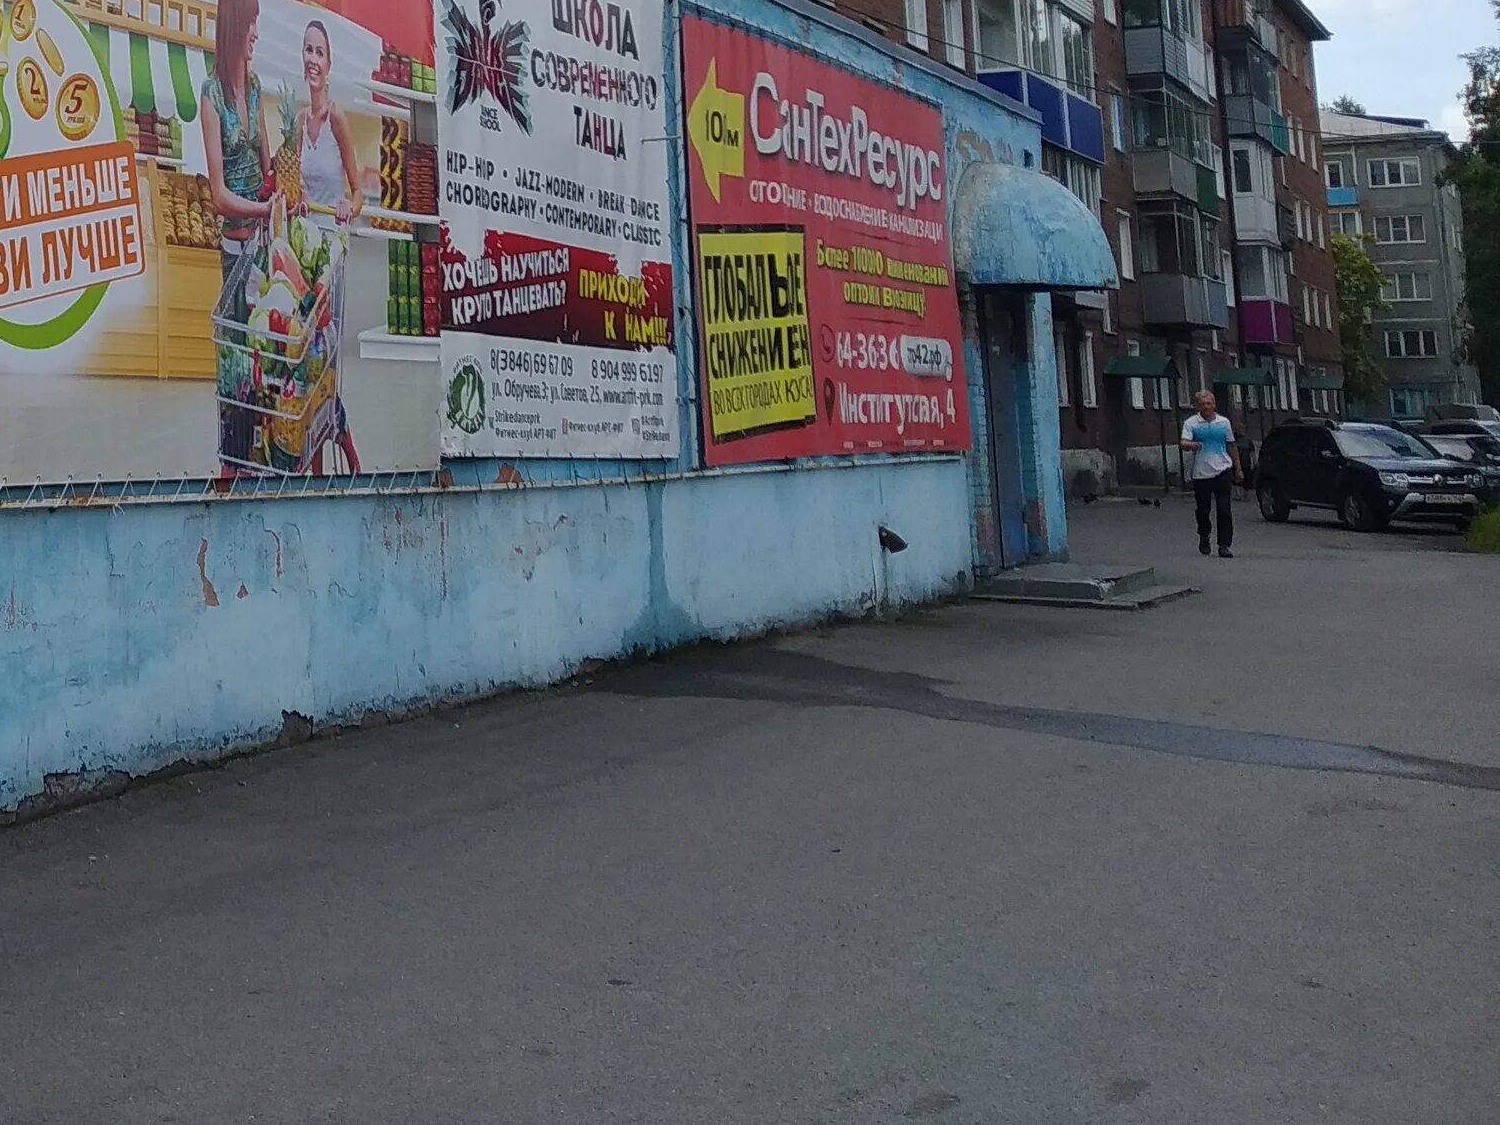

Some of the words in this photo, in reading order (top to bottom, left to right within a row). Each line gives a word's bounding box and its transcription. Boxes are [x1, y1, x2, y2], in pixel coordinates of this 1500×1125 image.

[24, 67, 41, 95] 2
[64, 83, 89, 114] 5
[531, 48, 658, 111] СОВРЕМЕННОГО
[573, 105, 627, 162] ТАНЦА
[751, 72, 942, 210] СанТехРесурс
[28, 158, 132, 227] МЕНЬШЕ
[515, 167, 585, 204] JAZZ-MODERN
[598, 188, 626, 215] BREAK
[630, 197, 660, 222] DANCE
[545, 202, 618, 239] CONTEMPORARY
[622, 221, 662, 247] CLASSIC
[41, 215, 138, 285] ЛУЧШЕ
[442, 258, 499, 292] ХОЧЕШЬ
[500, 247, 570, 283] НАУЧИТЬСЯ
[493, 279, 567, 318] ТАНЦЕВАТЬ?
[579, 268, 647, 308] ПРИХОДИ
[604, 310, 617, 340] К
[947, 388, 956, 424] 4
